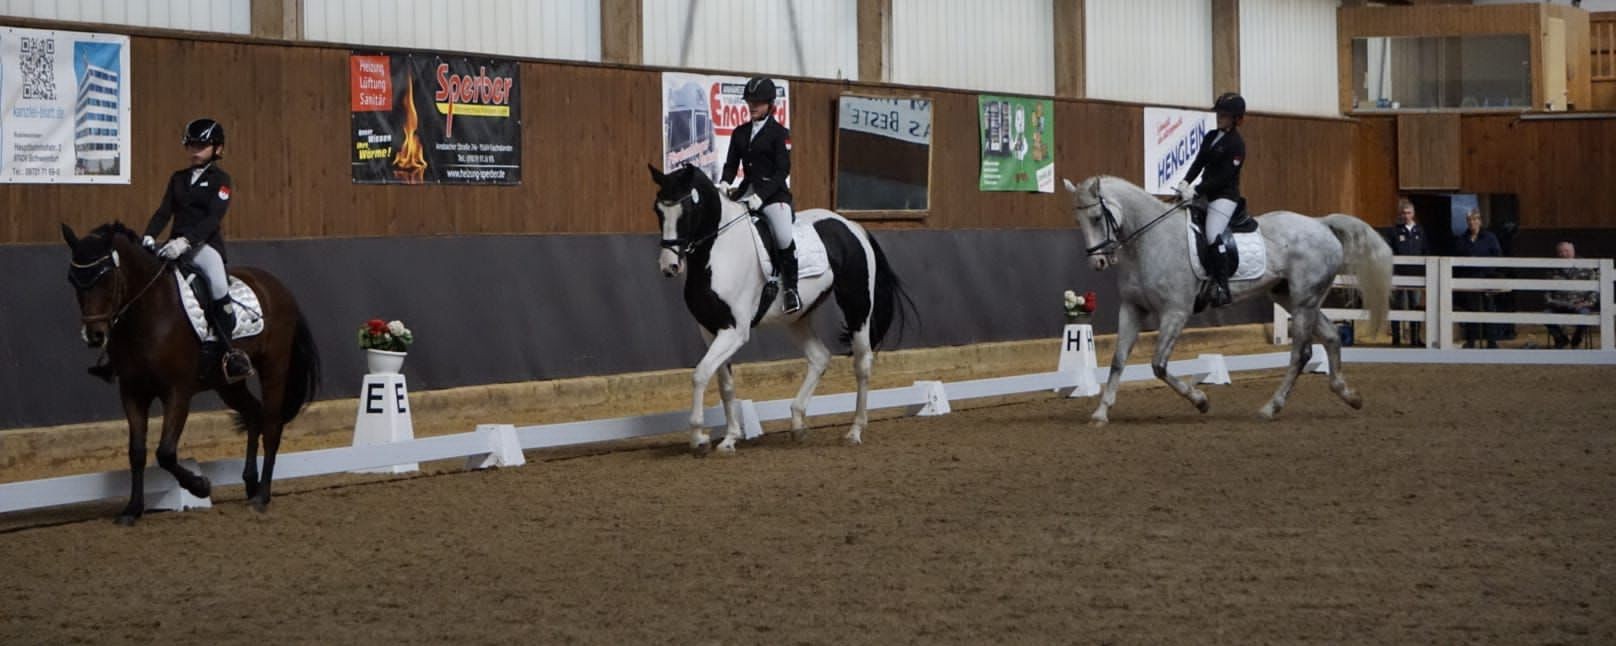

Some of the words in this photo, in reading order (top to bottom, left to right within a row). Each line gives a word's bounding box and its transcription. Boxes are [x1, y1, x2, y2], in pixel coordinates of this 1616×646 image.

[360, 60, 385, 76] Heizung
[360, 77, 387, 93] Lüftung
[360, 93, 386, 106] Sanitär
[436, 63, 513, 138] Sperber
[1158, 119, 1206, 187] HENGLEIN
[1067, 330, 1081, 351] H
[366, 383, 384, 413] E
[395, 383, 406, 413] E
